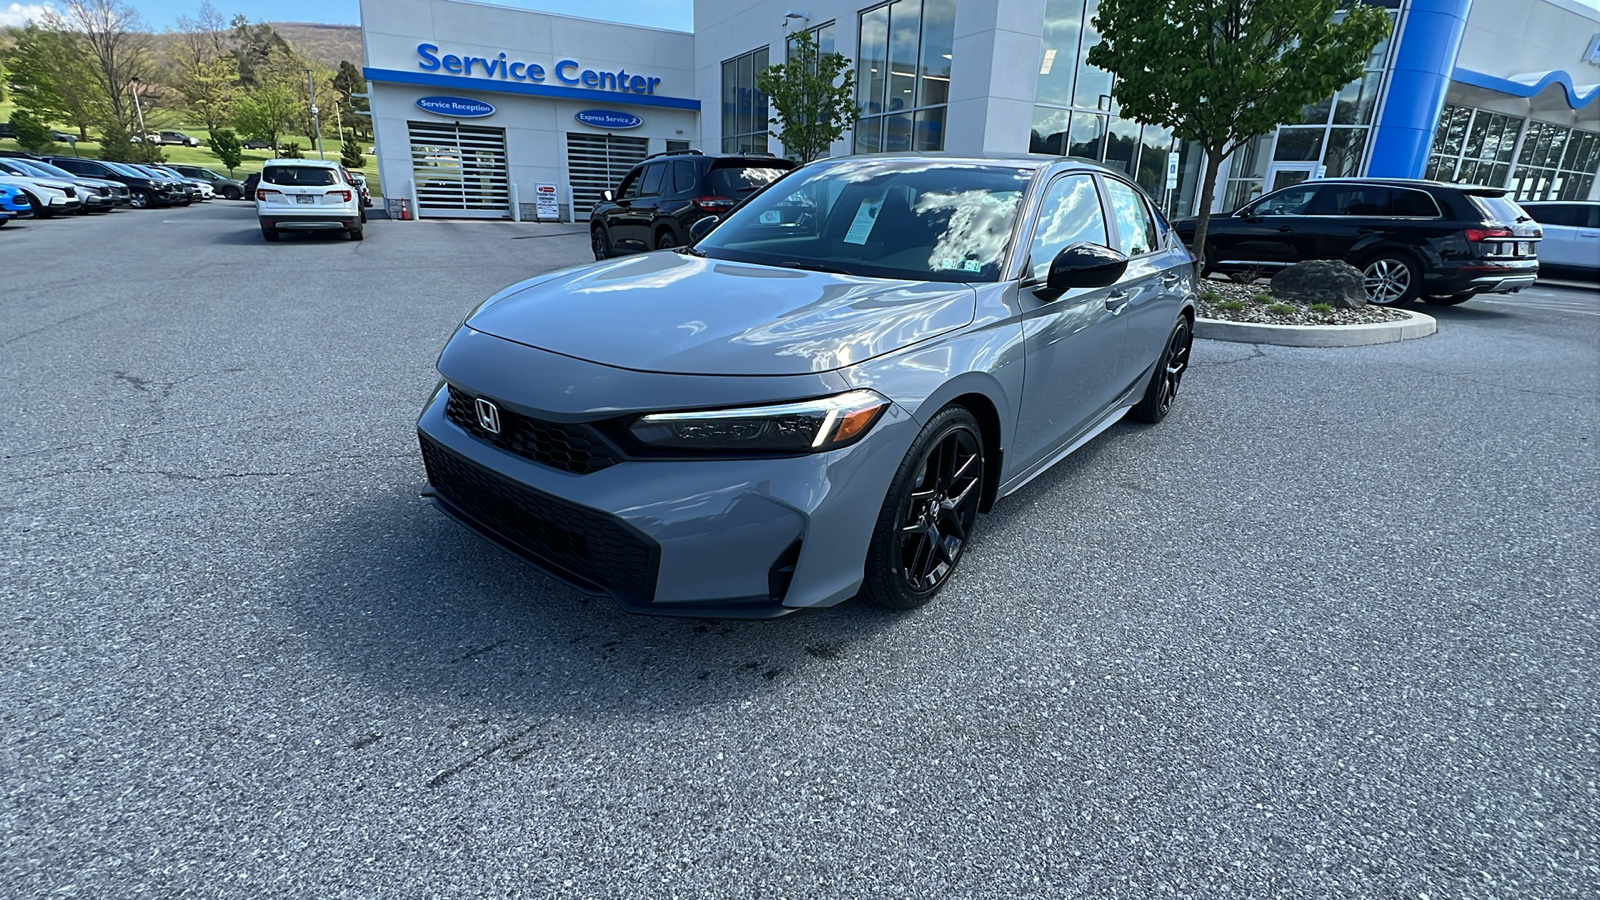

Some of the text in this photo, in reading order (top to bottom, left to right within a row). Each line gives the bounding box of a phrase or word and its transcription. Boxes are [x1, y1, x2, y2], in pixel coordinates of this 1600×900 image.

[417, 43, 661, 94] Service Center
[421, 99, 490, 112] Service Reception
[580, 113, 629, 123] Express Service
